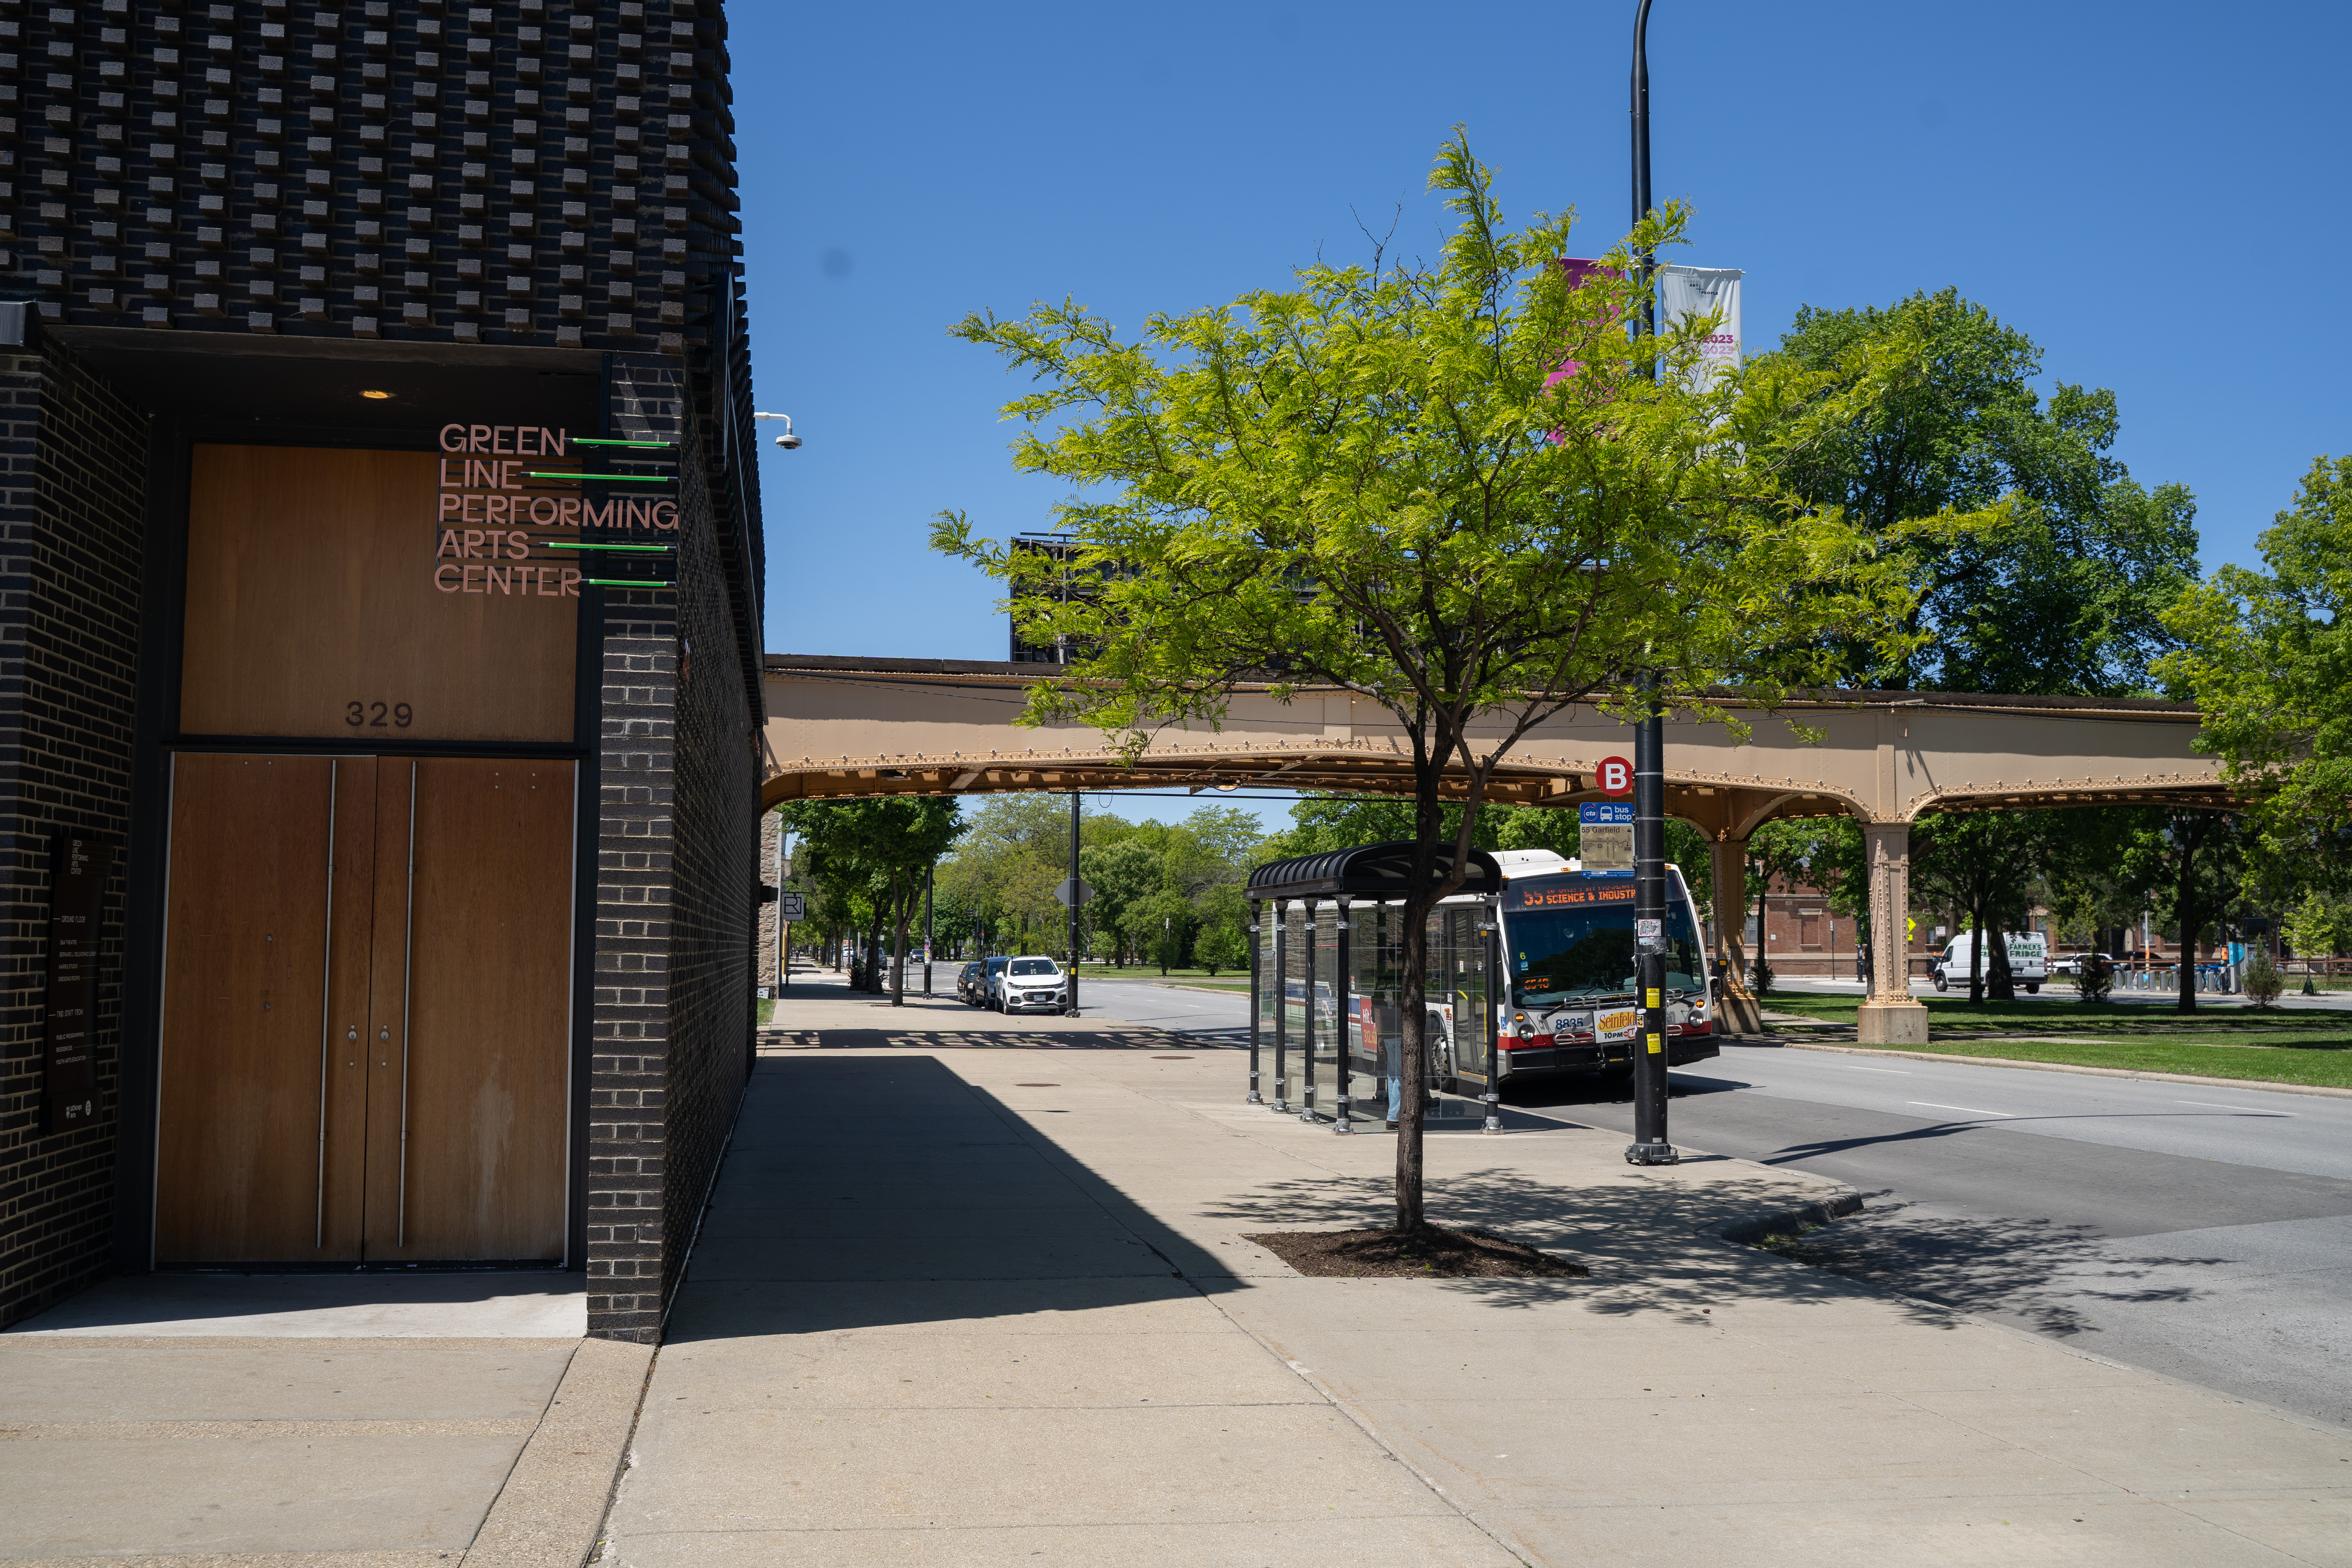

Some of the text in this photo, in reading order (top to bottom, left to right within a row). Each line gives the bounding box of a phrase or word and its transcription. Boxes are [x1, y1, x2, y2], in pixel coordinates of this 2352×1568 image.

[1702, 345, 1733, 354] 2023
[1703, 334, 1733, 343] 2023
[440, 424, 565, 456] GREEN
[440, 459, 523, 489] LINE
[439, 494, 679, 529] PERFORMING
[437, 529, 529, 559] ARTS
[434, 564, 582, 597] CENTER
[346, 701, 412, 728] 329
[1605, 764, 1627, 789] B
[1615, 813, 1632, 822] stop
[1524, 891, 1543, 906] 55
[1546, 893, 1585, 904] SCIENCE
[1599, 889, 1635, 900] INDUSTR
[1555, 1018, 1583, 1030] 8835
[1599, 1012, 1635, 1030] Seinfeld
